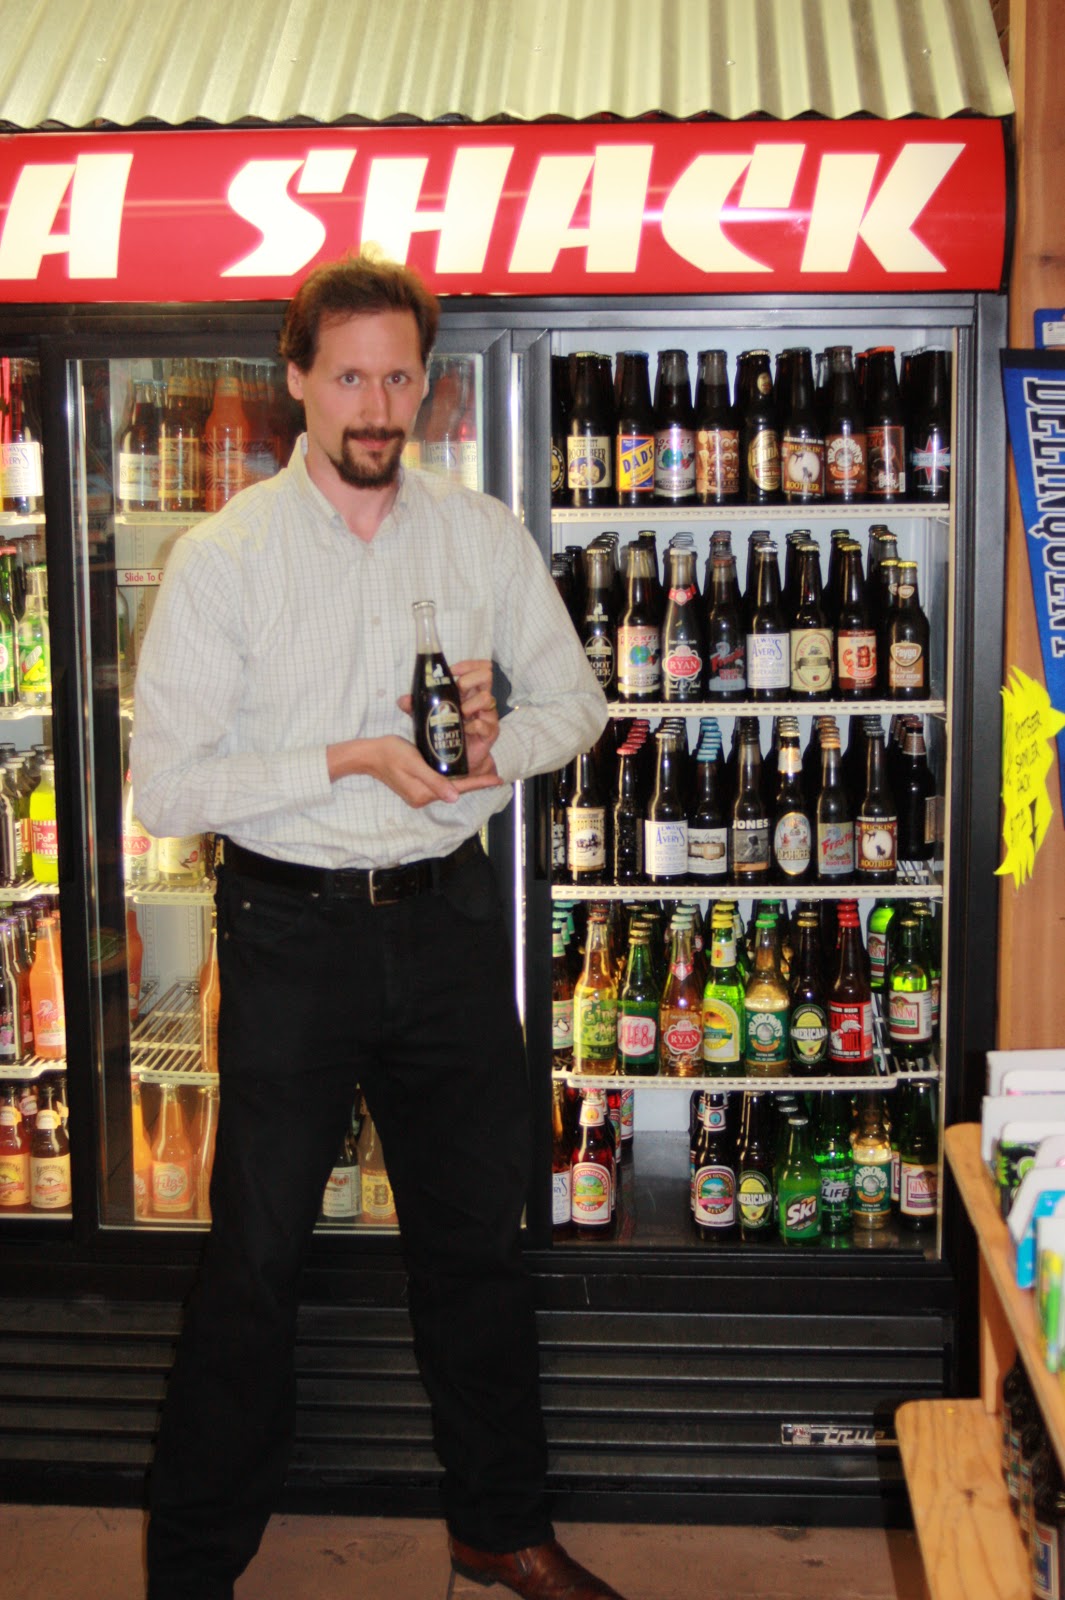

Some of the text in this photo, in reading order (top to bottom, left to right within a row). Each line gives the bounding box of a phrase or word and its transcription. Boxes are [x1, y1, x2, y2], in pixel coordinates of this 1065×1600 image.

[0, 142, 966, 279] A SHACK
[622, 445, 654, 473] DAD'S
[125, 572, 143, 582] Slide
[147, 572, 155, 581] To
[895, 646, 917, 659] Faygo
[670, 661, 697, 669] RYAN
[434, 730, 460, 741] ROOT
[434, 740, 462, 750] BEER
[732, 818, 769, 829] JONES
[670, 1033, 698, 1044] RYAN
[821, 1188, 850, 1198] LIFE
[786, 1200, 817, 1226] SKI
